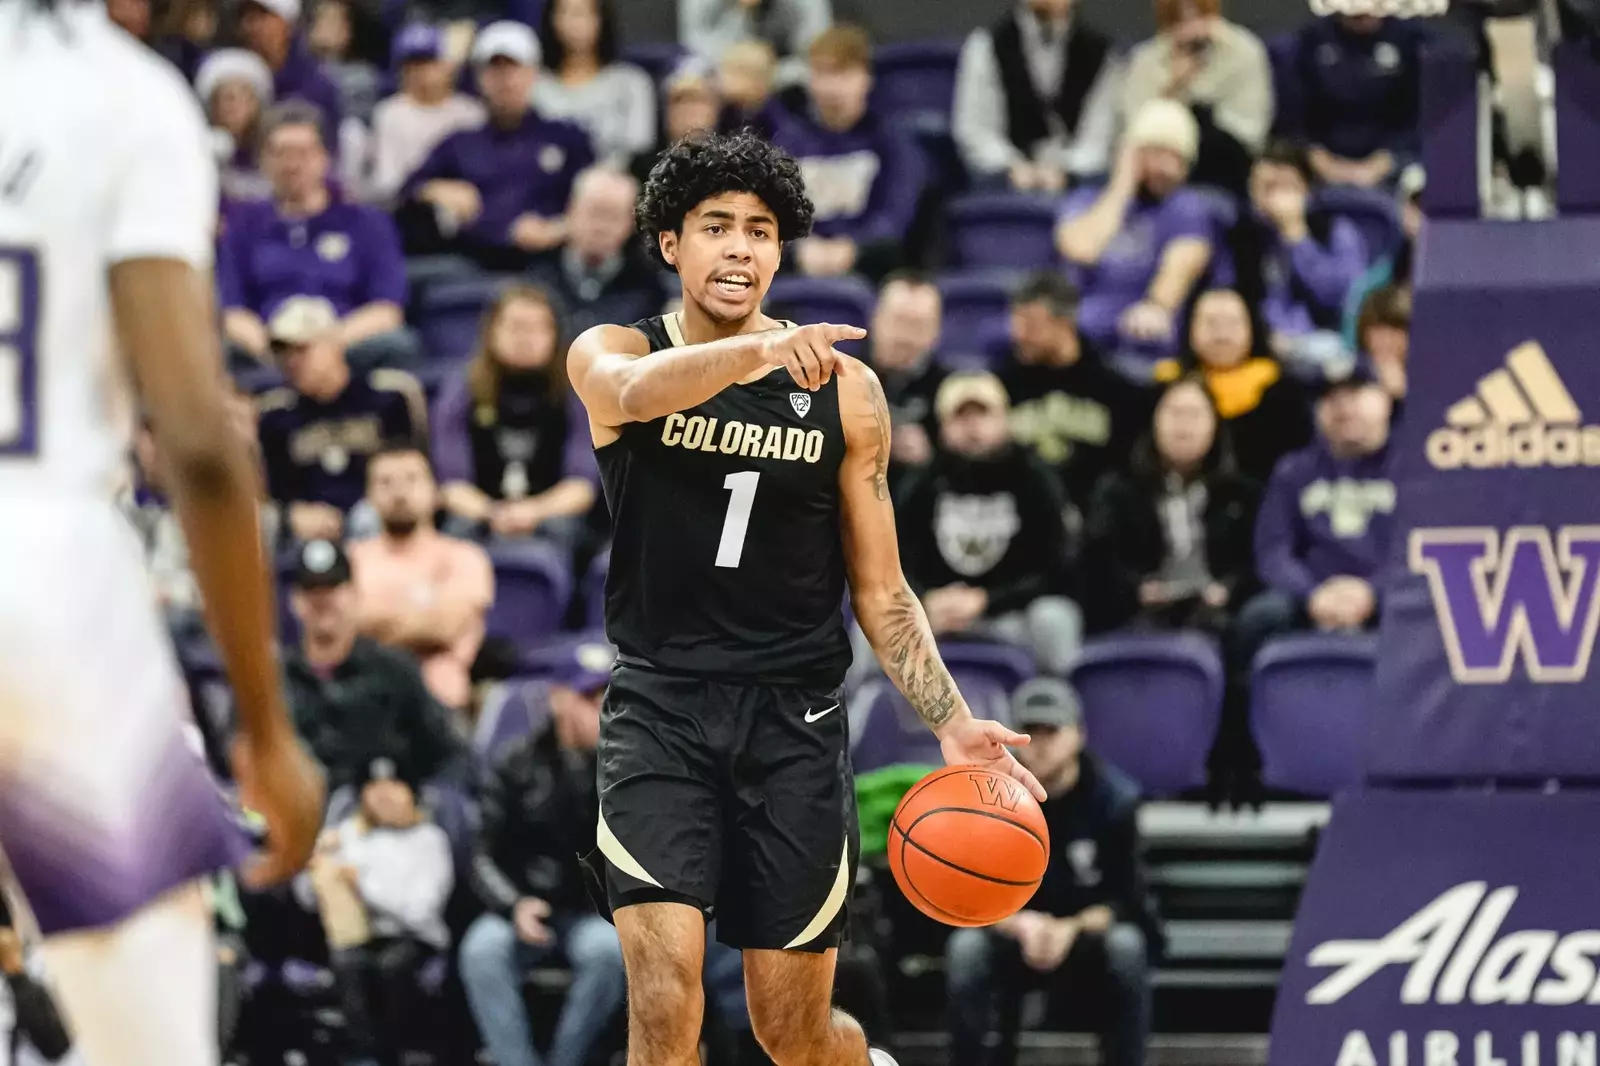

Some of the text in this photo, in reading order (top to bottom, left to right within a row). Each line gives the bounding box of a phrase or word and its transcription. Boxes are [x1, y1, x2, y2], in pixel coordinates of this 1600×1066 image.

[661, 413, 824, 463] COLORADO
[796, 402, 806, 412] 12
[715, 471, 760, 568] 1
[1408, 525, 1600, 683] W
[969, 774, 1025, 812] W
[1306, 880, 1600, 1005] Alas
